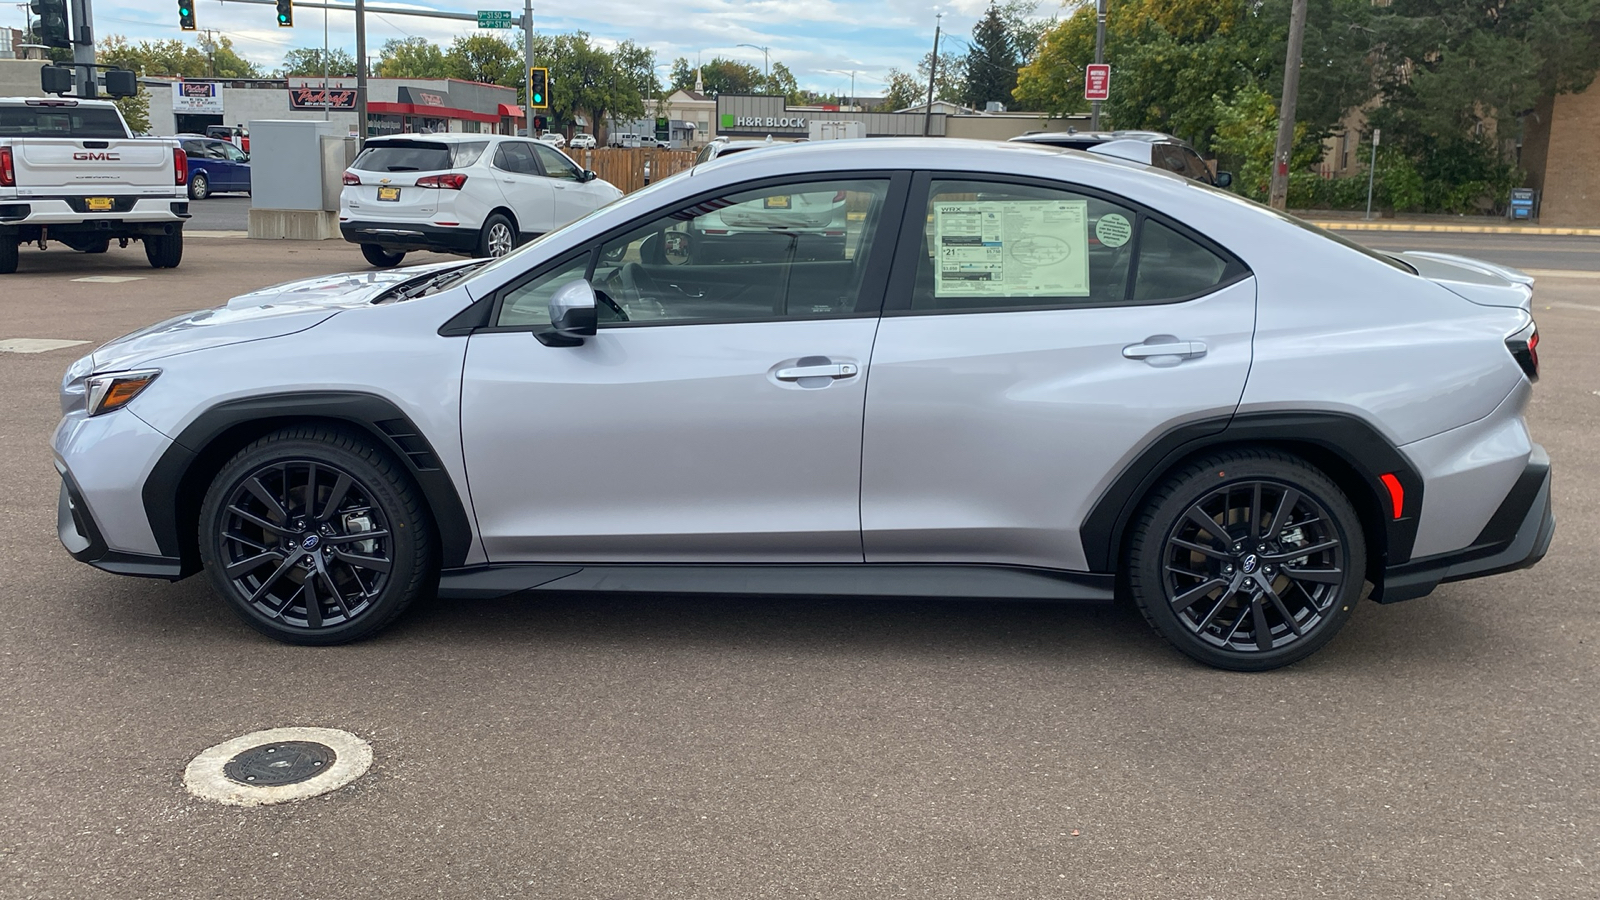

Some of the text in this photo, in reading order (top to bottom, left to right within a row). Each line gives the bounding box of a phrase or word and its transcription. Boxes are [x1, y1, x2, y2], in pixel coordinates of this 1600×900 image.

[737, 116, 805, 128] H&R BLOCK
[73, 152, 121, 161] GMC
[946, 248, 955, 256] 21
